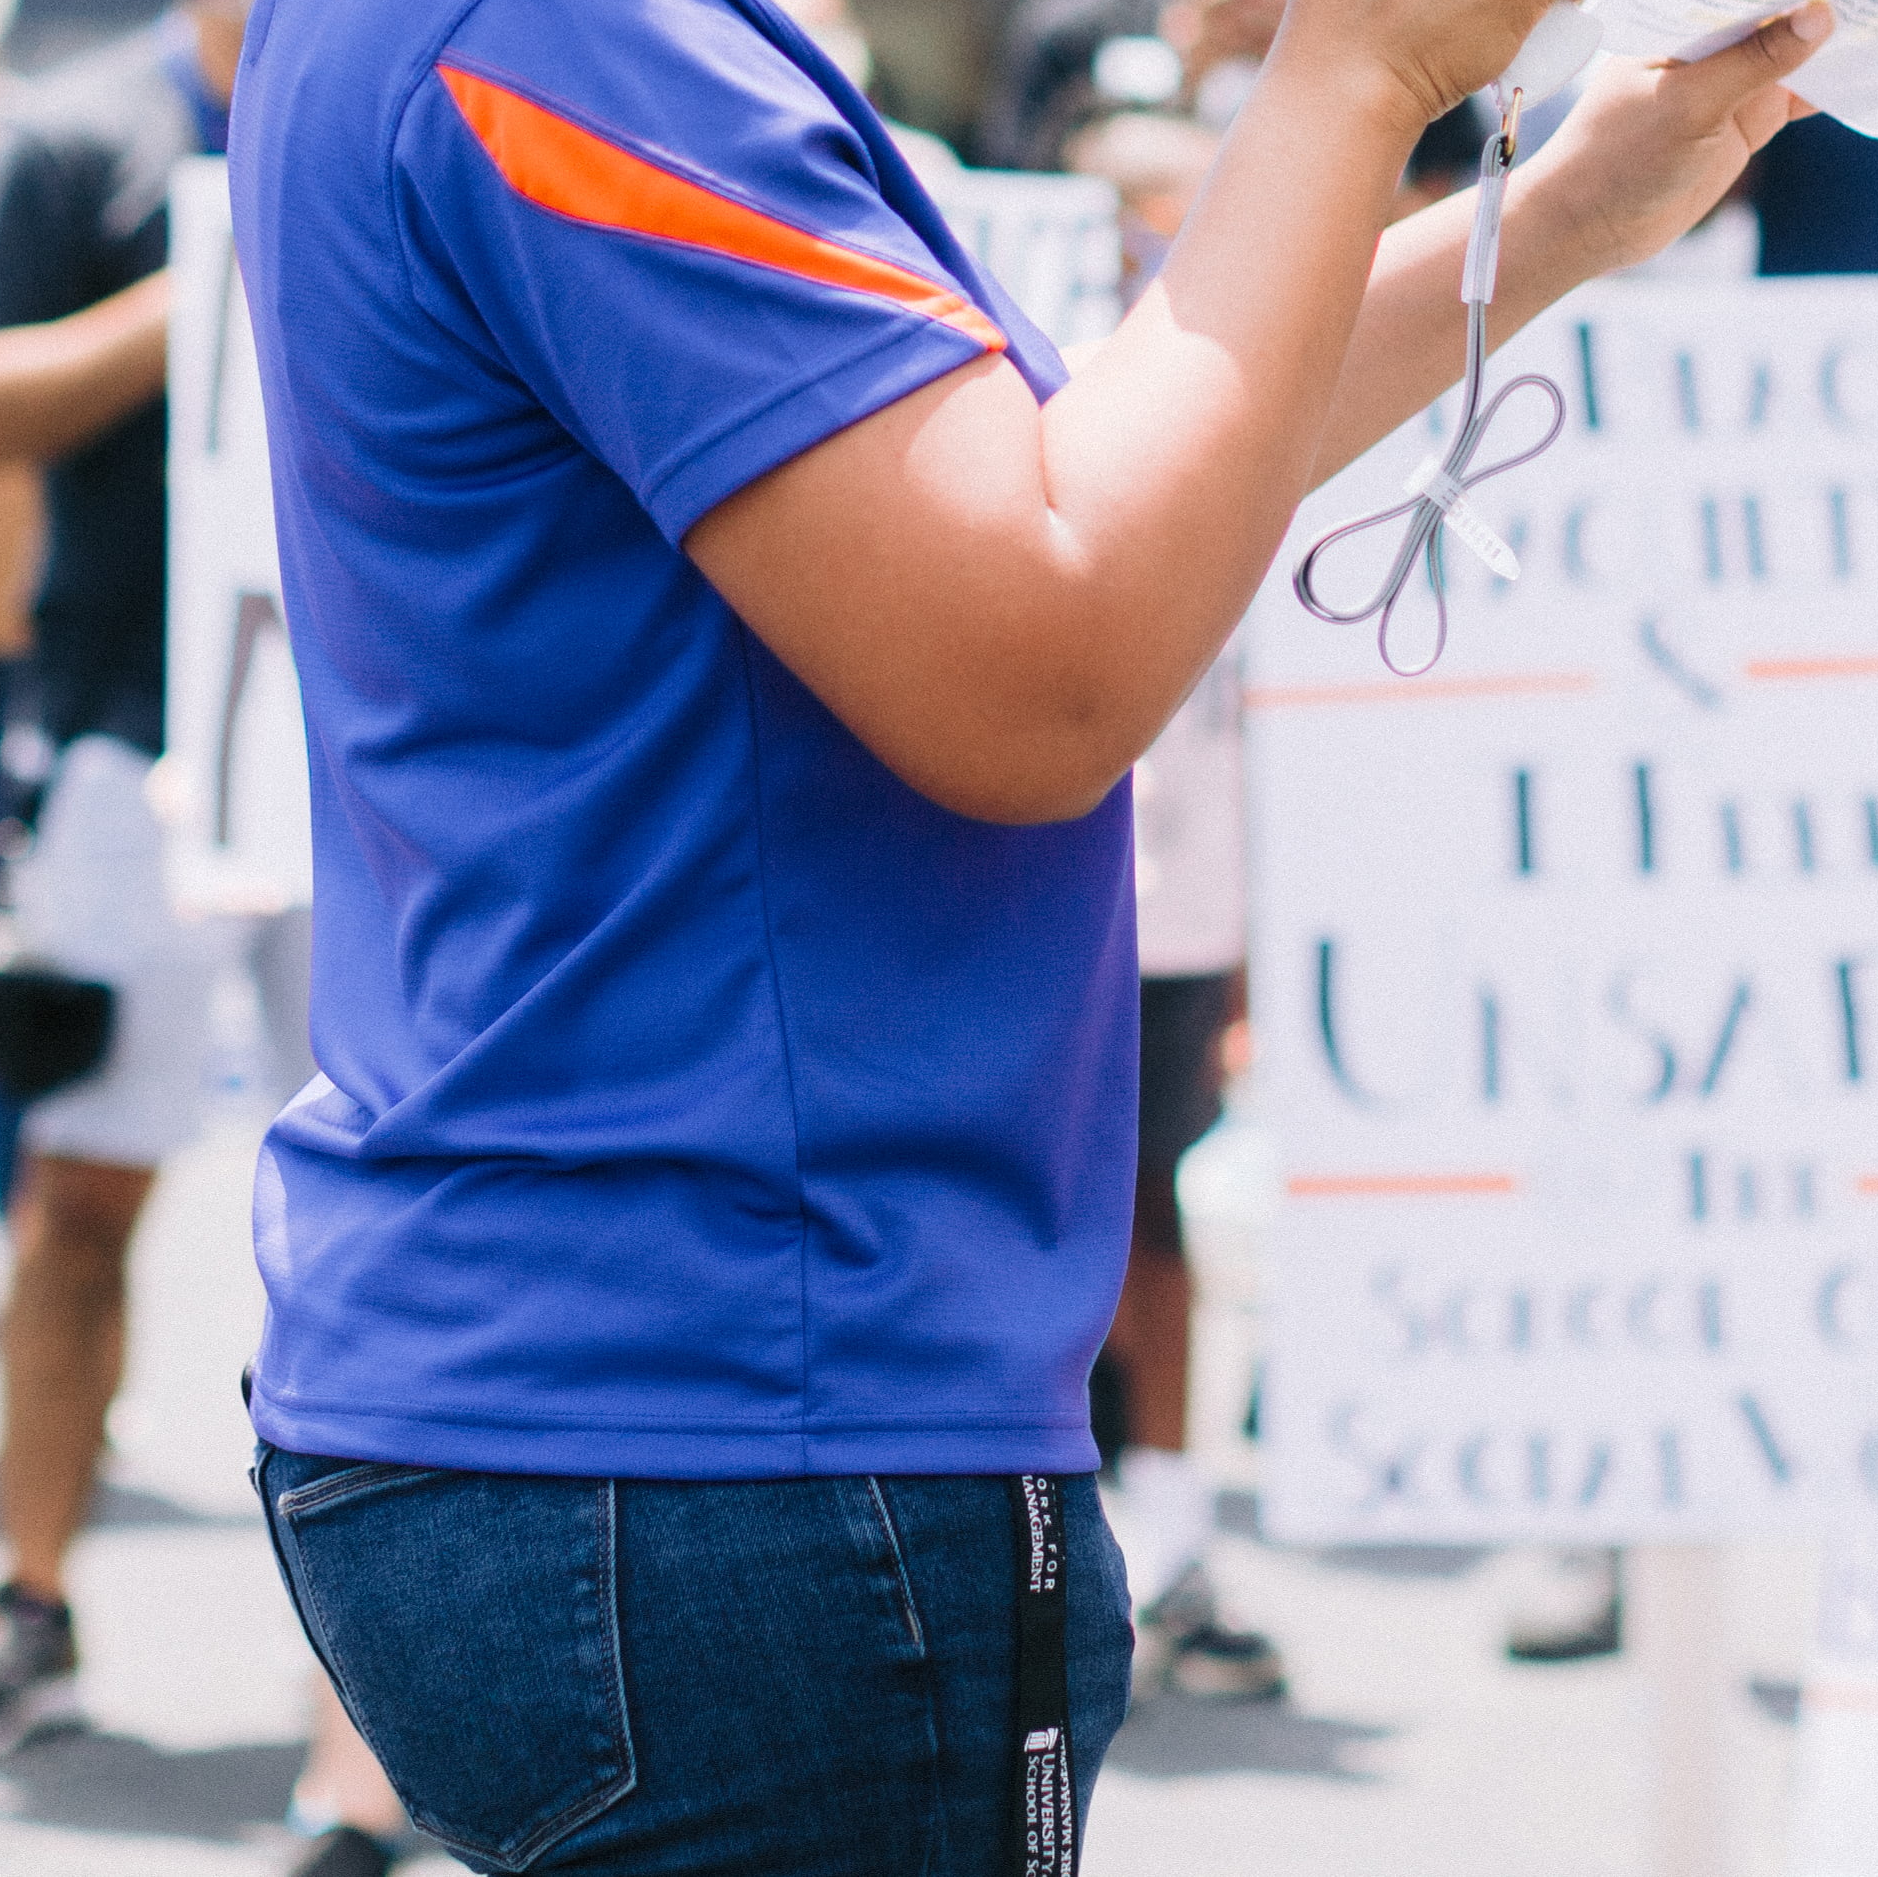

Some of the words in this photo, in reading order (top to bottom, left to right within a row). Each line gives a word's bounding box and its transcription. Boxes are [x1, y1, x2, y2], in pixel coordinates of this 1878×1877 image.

[1044, 1543, 1057, 1591] FOR
[1026, 1755, 1040, 1827] SCHOOL
[1041, 1753, 1056, 1873] UNIVERSITY
[1026, 1830, 1039, 1854] OF
